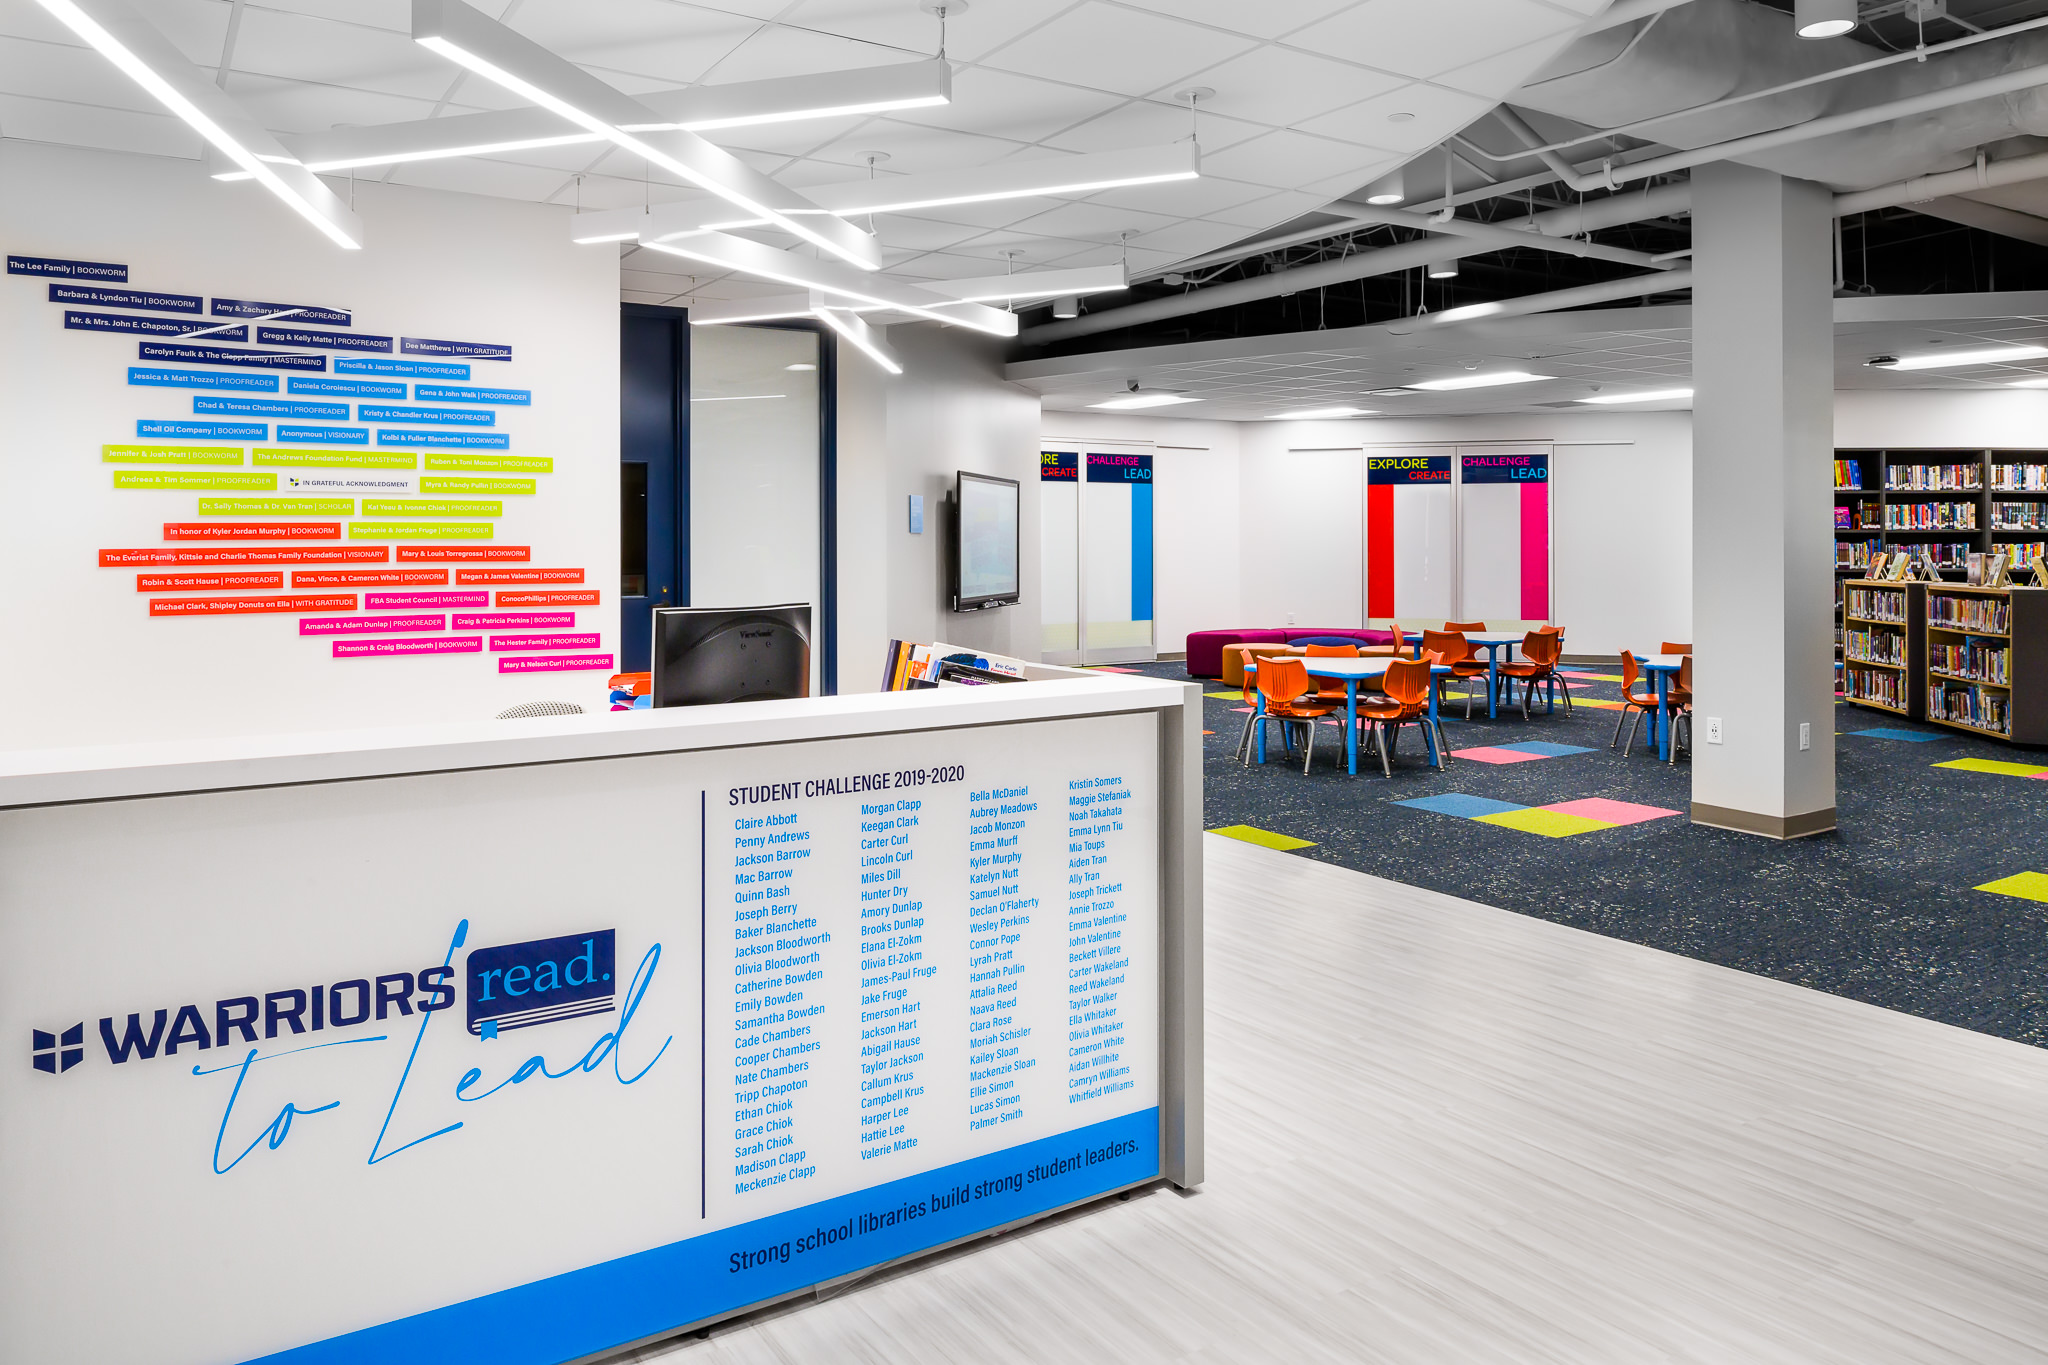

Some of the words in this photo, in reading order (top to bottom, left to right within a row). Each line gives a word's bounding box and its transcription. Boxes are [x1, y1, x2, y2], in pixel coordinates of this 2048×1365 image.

[43, 264, 71, 273] Family
[77, 267, 125, 276] BOOKWORM
[57, 290, 89, 298] Barbara
[99, 294, 129, 302] Lyndon
[148, 298, 195, 307] BOOKWORM
[262, 332, 285, 341] Gregg
[337, 338, 390, 347] PROOFREADER
[406, 342, 418, 350] Dee
[420, 344, 451, 352] Matthews
[474, 348, 508, 356] GRATITUDE
[220, 378, 274, 386] PROOFREADER
[281, 430, 323, 438] Anonymous
[1087, 455, 1139, 466] CHALLENGE
[1369, 458, 1428, 470] EXPLORE
[1463, 457, 1530, 466] CHALLENGE
[1042, 467, 1077, 477] CREATE
[1124, 468, 1151, 479] LEAD
[1409, 470, 1450, 480] CREATE
[1511, 468, 1547, 479] LEAD
[212, 528, 231, 536] Kyler
[150, 554, 177, 562] Family,
[278, 552, 302, 560] Family
[209, 602, 237, 610] Shipley
[729, 782, 801, 806] STUDENT
[805, 773, 891, 797] CHALLENGE
[894, 765, 965, 788] 2019-2020
[1069, 779, 1093, 790] Kristin
[1095, 777, 1122, 787] Somers
[970, 807, 998, 819] Aubrey
[1000, 802, 1037, 814] Meadows
[735, 817, 763, 830] Claire
[766, 813, 797, 827] Abbott
[1069, 827, 1092, 837] Emma
[1094, 825, 1110, 835] Lynn
[1112, 821, 1123, 831] Tiu
[861, 838, 889, 850] Carter
[891, 833, 908, 845] Curl
[970, 856, 991, 869] Kyler
[993, 852, 1022, 864] Murphy
[735, 874, 755, 885] Mac
[758, 869, 792, 882] Barrow
[1069, 874, 1082, 885] Ally
[1084, 872, 1100, 882] Tran
[861, 889, 891, 902] Hunter
[893, 886, 908, 897] Dry
[970, 905, 997, 917] Declan
[1000, 898, 1039, 912] O'Flaherty
[735, 926, 764, 939] Baker
[766, 918, 816, 934] Blanchette
[1069, 920, 1092, 931] Emma
[1094, 913, 1127, 926] Valentine
[861, 942, 885, 953] Elana
[888, 934, 922, 948] El-Zokm
[970, 953, 992, 968] Lyrah
[994, 950, 1013, 962] Pratt
[1069, 967, 1092, 978] Carter
[1094, 957, 1128, 973] Wakeland
[735, 977, 782, 994] Catherine
[785, 970, 822, 985] Bowden
[99, 965, 456, 1064] WARRIORS
[478, 939, 611, 1003] read.
[861, 993, 880, 1005] Jake
[883, 989, 907, 1000] Fruge
[970, 1004, 994, 1016] Naava
[997, 996, 1016, 1010] Reed
[1069, 1014, 1082, 1026] Ella
[1084, 1008, 1117, 1022] Whitaker
[735, 1035, 760, 1049] Cade
[762, 1026, 811, 1043] Chambers
[192, 1036, 388, 1175] to
[367, 918, 673, 1165] Lead
[861, 1041, 891, 1057] Abigail
[894, 1037, 920, 1050] Hause
[970, 1052, 995, 1065] Kailey
[997, 1047, 1018, 1059] Sloan
[1069, 1061, 1090, 1073] Aidan
[1092, 1053, 1119, 1067] Willhite
[734, 1090, 759, 1104] Tripp
[762, 1080, 807, 1097] Chapoton
[861, 1089, 902, 1108] Campbell
[905, 1086, 924, 1098] Krus
[970, 1102, 993, 1114] Lucas
[996, 1095, 1020, 1108] Simon
[735, 1141, 763, 1158] Sarah
[766, 1134, 793, 1150] Chiok
[861, 1144, 892, 1160] Valerie
[894, 1138, 917, 1151] Matte
[729, 1240, 791, 1274] Strong
[796, 1219, 853, 1254] school
[858, 1202, 926, 1236] libraries
[931, 1187, 970, 1214] build
[974, 1171, 1023, 1200] strong
[1027, 1152, 1082, 1184] student
[1085, 1137, 1139, 1167] leaders.
